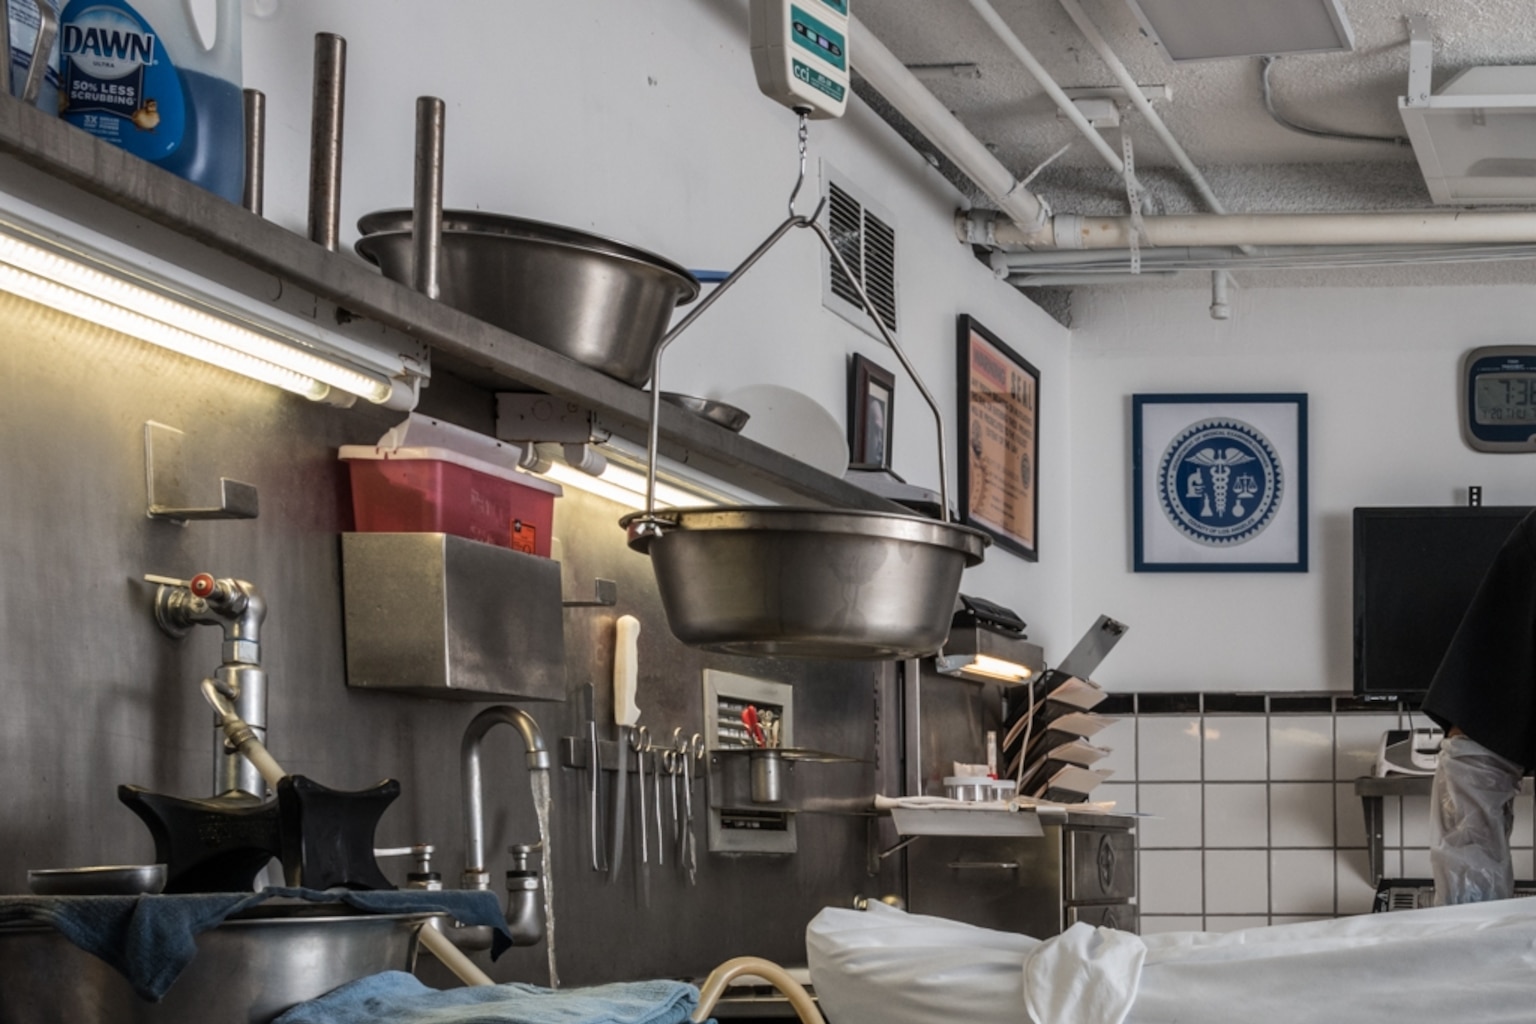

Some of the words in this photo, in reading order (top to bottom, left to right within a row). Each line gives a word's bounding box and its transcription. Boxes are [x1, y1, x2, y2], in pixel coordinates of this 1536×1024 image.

[62, 24, 154, 65] DAWN
[71, 91, 135, 106] SCRUBBING
[73, 80, 98, 92] 50%
[101, 83, 135, 97] LESS
[1011, 370, 1033, 411] SEAL
